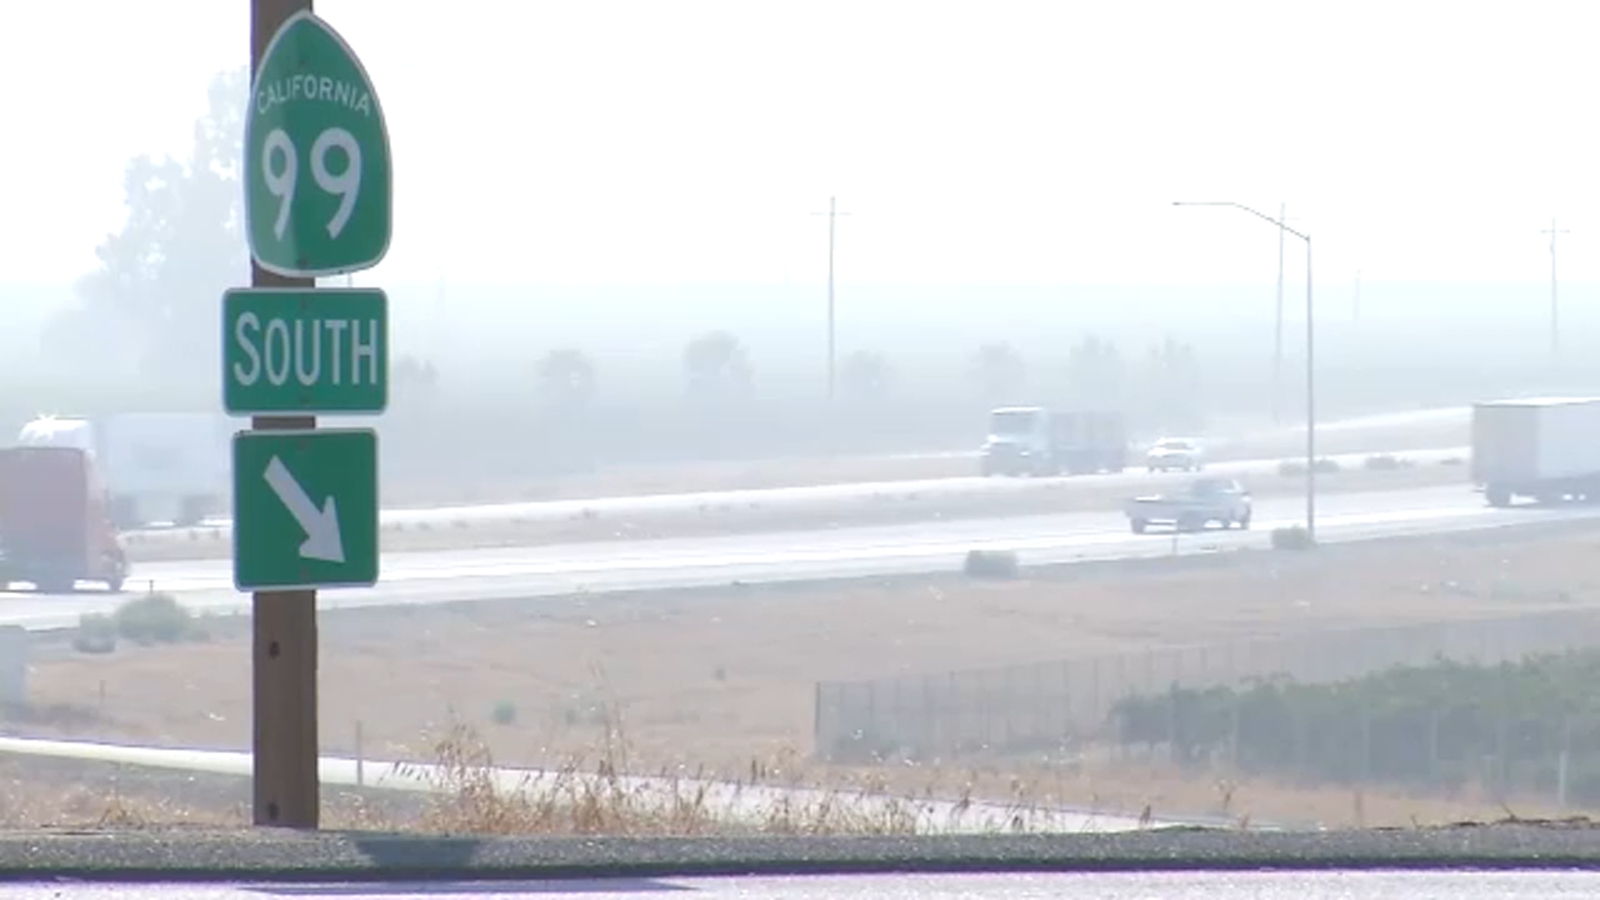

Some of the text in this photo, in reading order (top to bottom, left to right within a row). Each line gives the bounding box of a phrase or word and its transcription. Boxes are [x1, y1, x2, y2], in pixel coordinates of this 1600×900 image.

[257, 74, 370, 116] CALIFORNIA
[262, 127, 361, 241] 99
[233, 311, 378, 386] SOUTH
